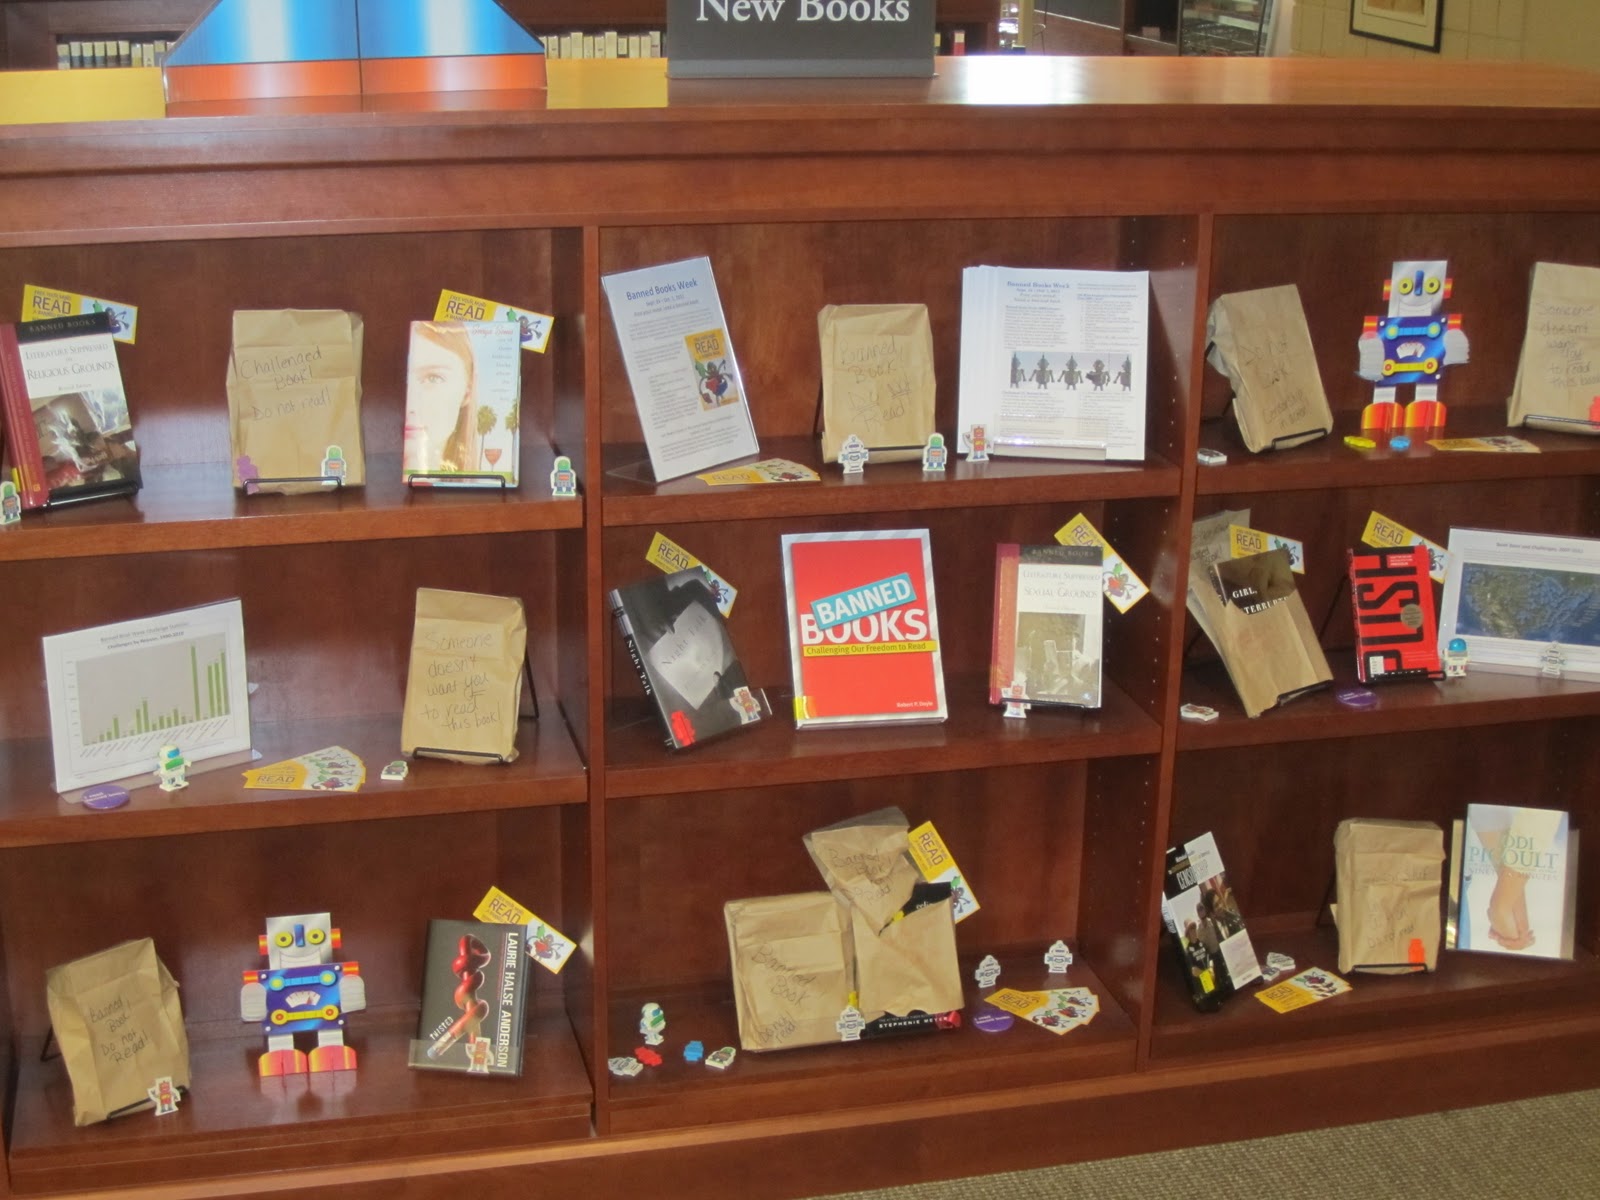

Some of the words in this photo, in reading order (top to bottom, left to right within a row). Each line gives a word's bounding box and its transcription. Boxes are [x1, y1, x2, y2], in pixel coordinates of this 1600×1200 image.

[697, 0, 785, 21] New
[797, 0, 910, 22] Books
[626, 287, 654, 300] Banned
[655, 283, 677, 295] Books
[677, 278, 698, 290] Week
[32, 295, 72, 315] READ
[446, 300, 486, 320] READ
[29, 323, 64, 333] BANNED
[67, 319, 97, 329] BOOKS
[695, 338, 720, 354] READ
[27, 367, 70, 381] RELIGIOUS
[71, 361, 116, 375] GROUNDS
[240, 345, 322, 380] Challenged
[251, 406, 272, 421] Do
[277, 400, 295, 417] not
[1236, 534, 1262, 550] READ
[1374, 521, 1404, 545] READ
[658, 543, 689, 570] READ
[816, 578, 912, 625] BANNED
[1024, 586, 1053, 597] SEXUAL
[1057, 586, 1098, 598] GROUNDS
[1232, 587, 1258, 599] GIRL,
[1353, 546, 1424, 681] PUSH
[800, 608, 928, 645] BOOKS
[425, 631, 494, 650] Someone
[661, 640, 689, 665] Night
[688, 615, 709, 636] Talk
[806, 645, 850, 656] Challenging
[851, 645, 865, 653] Our
[866, 643, 898, 653] Freedom
[898, 643, 907, 651] to
[908, 642, 926, 651] Read
[627, 640, 641, 670] Night
[640, 672, 652, 696] Talk
[426, 682, 457, 697] want
[463, 672, 489, 699] you
[419, 703, 440, 721] to
[446, 698, 480, 717] read
[441, 717, 471, 732] this
[256, 774, 296, 785] READ
[918, 831, 944, 866] READ
[1503, 835, 1534, 850] ODI
[489, 897, 523, 924] READ
[505, 932, 519, 969] LAURIE
[502, 971, 516, 1007] HALSE
[1266, 986, 1293, 1000] READ
[999, 994, 1029, 1009] READ
[429, 1016, 454, 1041] TWISTED
[879, 1020, 921, 1029] STEPHENIE
[497, 1009, 512, 1068] ANDERSON
